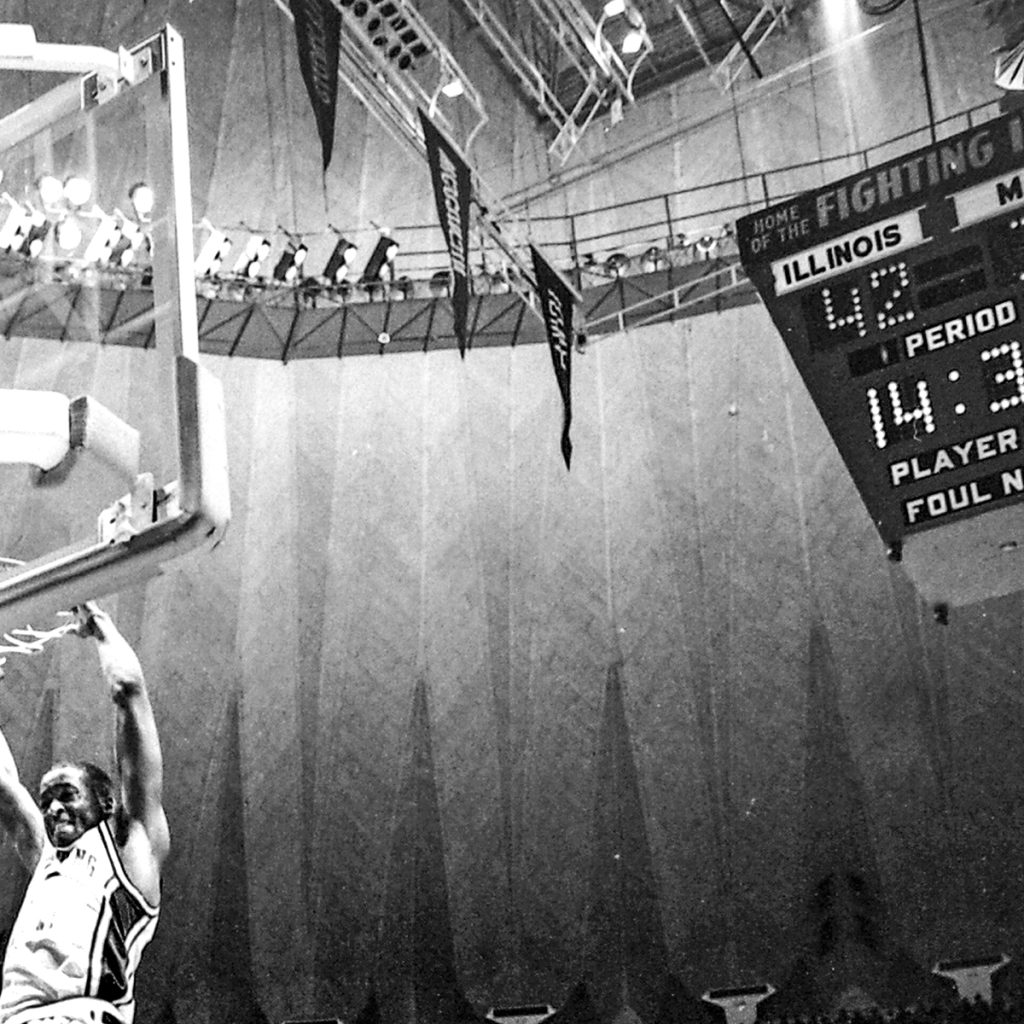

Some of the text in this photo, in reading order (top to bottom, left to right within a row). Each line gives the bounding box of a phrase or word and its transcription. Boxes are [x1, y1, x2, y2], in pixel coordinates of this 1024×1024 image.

[816, 130, 995, 228] FIGHTING
[751, 218, 810, 254] OF THE
[753, 205, 800, 235] HOME
[782, 224, 902, 286] ILLINOIS
[822, 261, 914, 337] 42
[905, 300, 1017, 358] PERIOD
[890, 427, 1019, 486] PLAYER
[906, 482, 992, 523] FOUL
